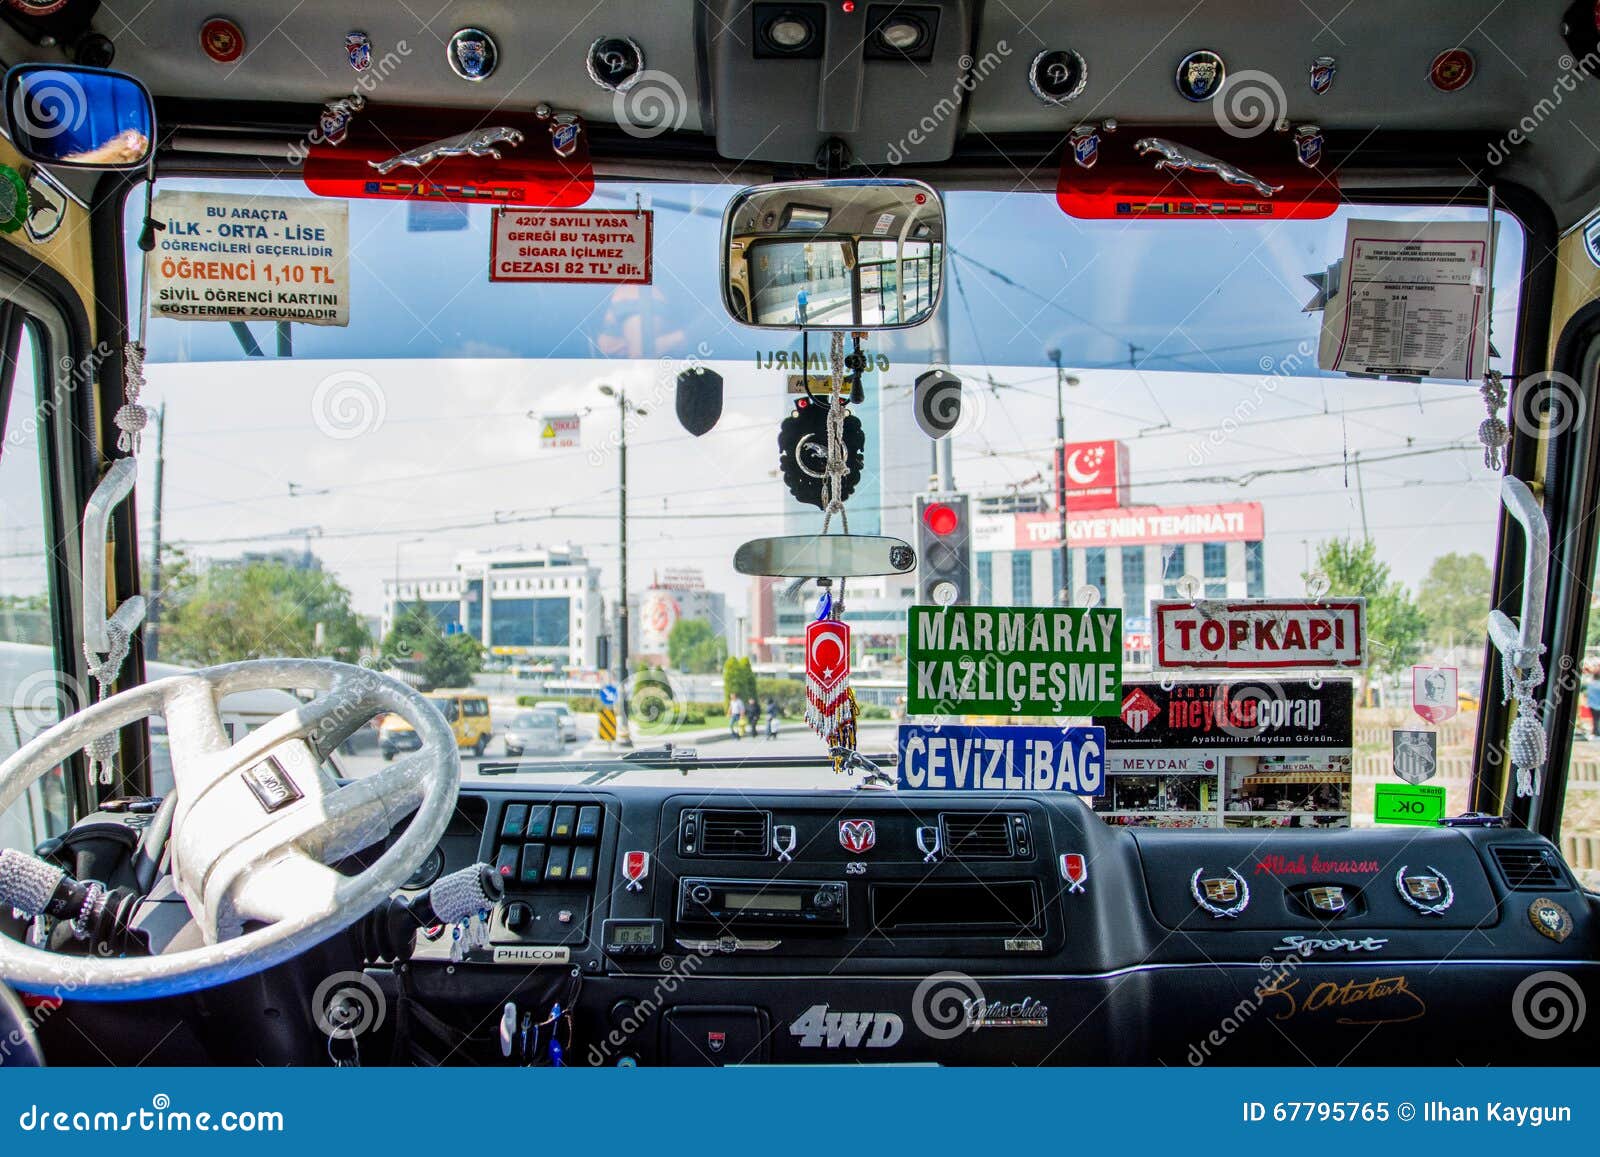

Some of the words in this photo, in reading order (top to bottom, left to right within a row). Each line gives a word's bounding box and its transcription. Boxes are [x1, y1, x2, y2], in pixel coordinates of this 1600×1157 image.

[207, 207, 226, 217] BU
[231, 208, 287, 222] ARAÇTA
[515, 217, 545, 227] 4207
[550, 218, 590, 227] SAYILI
[595, 218, 628, 228] YASA
[168, 218, 200, 235] İLK
[217, 224, 268, 239] ORTA
[285, 225, 325, 241] LİSE
[508, 231, 556, 242] GEREĞİ
[560, 233, 578, 242] BU
[581, 233, 635, 245] TAŞITTA
[161, 239, 250, 254] ÖĞRENCİLERİ
[255, 245, 333, 257] GEÇERLİDİR
[519, 246, 567, 257] SİGARA
[161, 257, 256, 281] ÖĞRENCİ
[263, 263, 305, 285] 1,10
[310, 266, 335, 284] TL
[501, 262, 560, 273] CEZASI
[565, 263, 583, 273] 82
[617, 264, 641, 275] dir.
[159, 287, 200, 301] SİVİL
[204, 288, 273, 303] ÖĞRENCİ
[277, 292, 338, 305] KARTINI
[160, 304, 246, 316] GÖSTERMEK
[250, 307, 337, 319] ZORUNDADIR
[918, 612, 1117, 652] MARMARAY
[1175, 619, 1345, 651] TOPKAPI
[917, 661, 1115, 712] KAZLIÇEŞME
[1254, 735, 1291, 744] Meydan
[1123, 759, 1188, 770] MEYDAN
[846, 862, 867, 874] SS
[1254, 854, 1307, 875] Allah
[1311, 854, 1380, 873] korusun
[498, 950, 553, 959] PHILCO
[1272, 936, 1389, 957] Sport
[789, 1004, 904, 1047] 4WD
